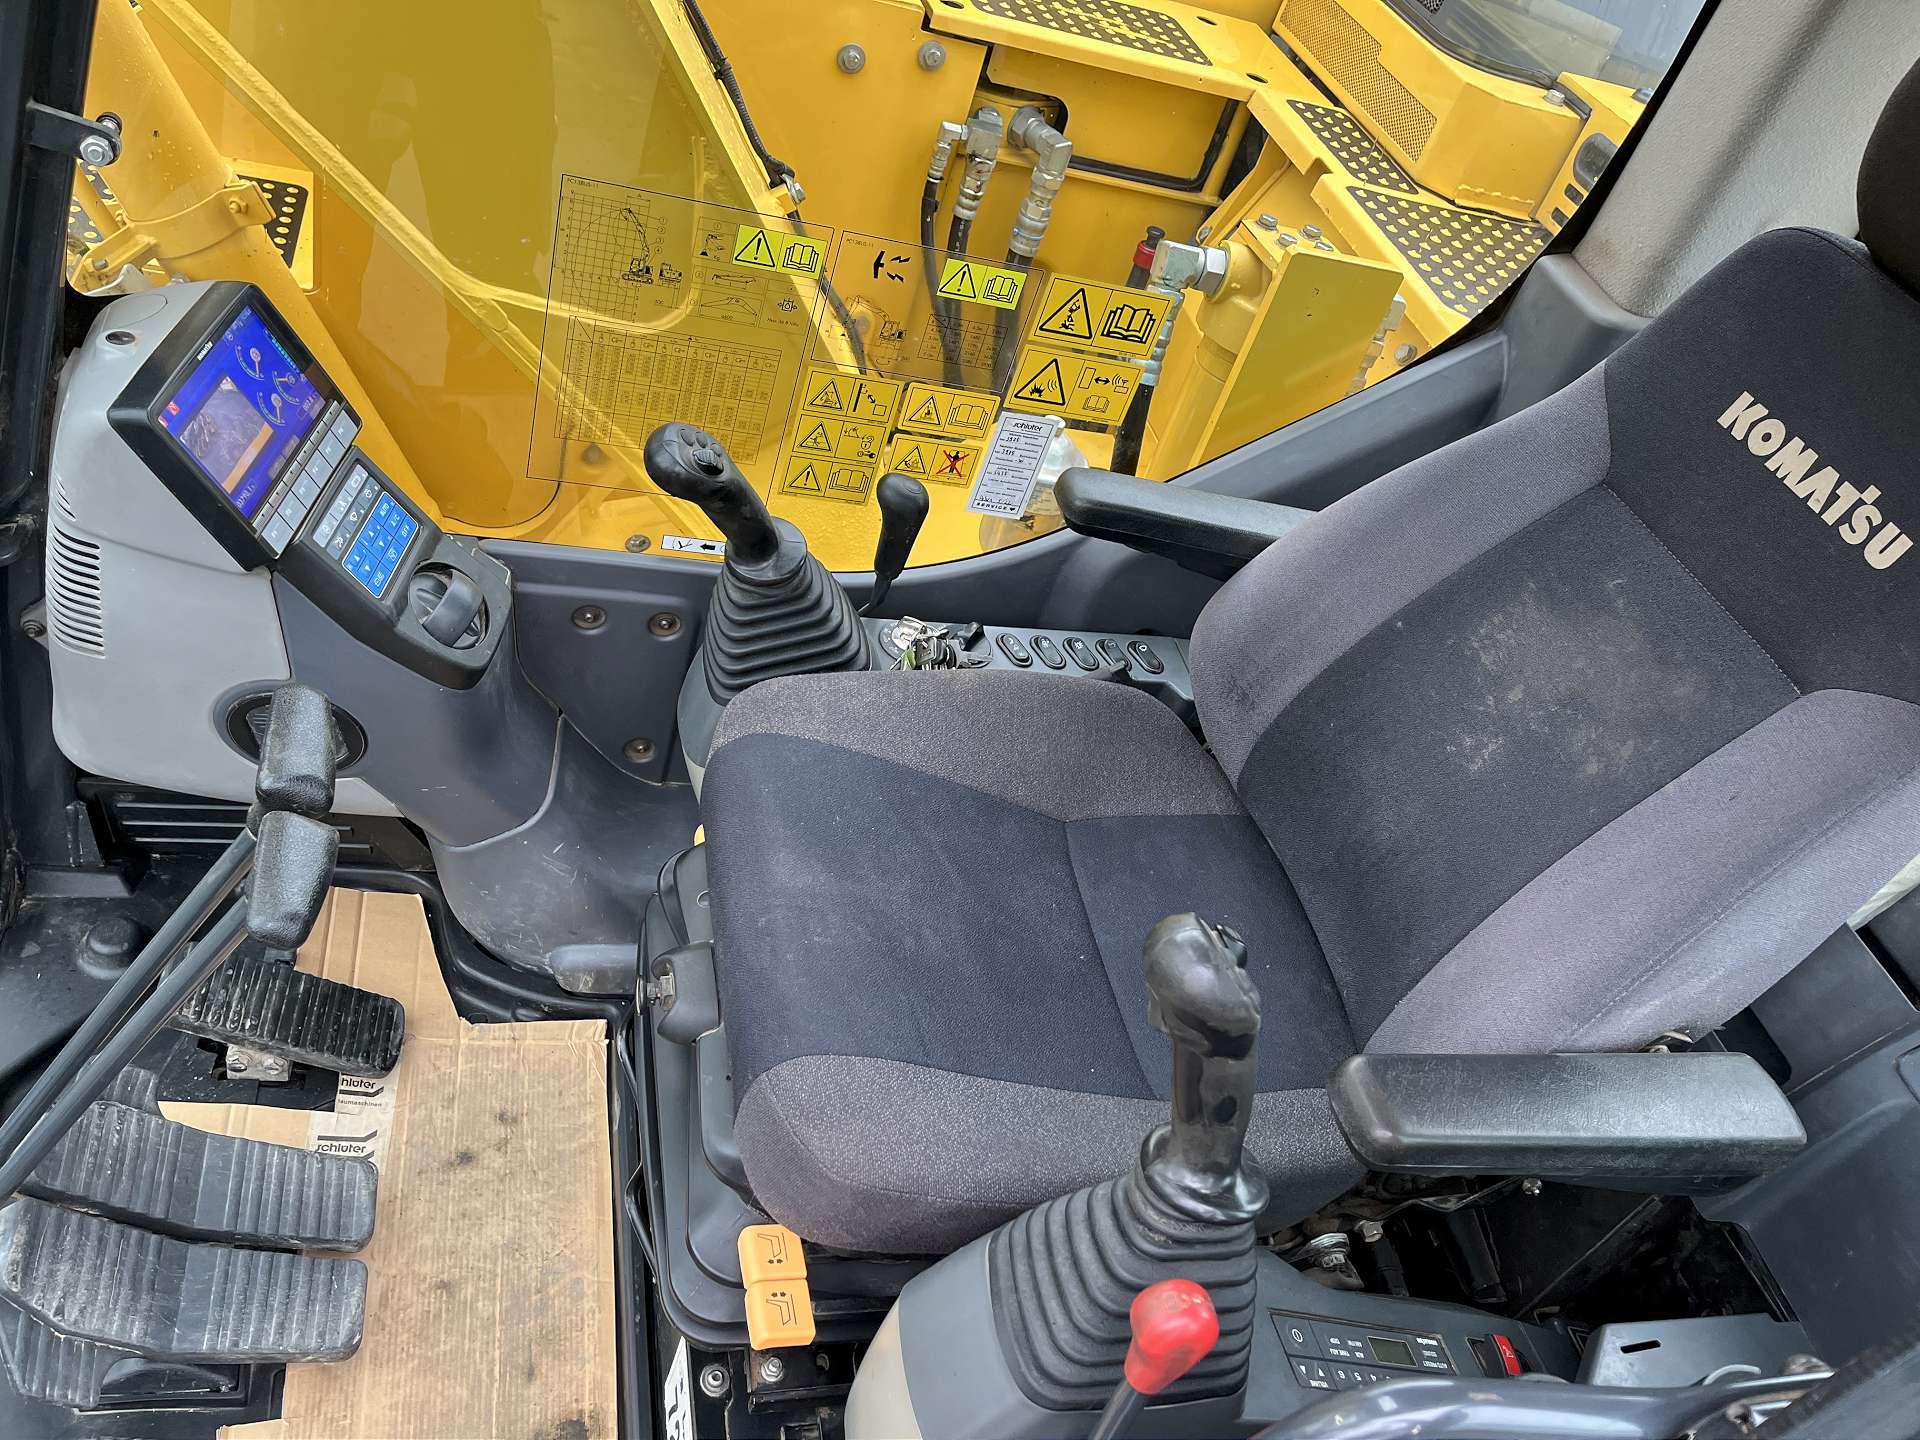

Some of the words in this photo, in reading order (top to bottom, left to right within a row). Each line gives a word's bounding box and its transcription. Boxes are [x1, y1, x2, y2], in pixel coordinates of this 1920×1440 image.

[1717, 390, 1914, 570] KOMATSU
[976, 502, 1008, 511] SERVICE
[391, 513, 400, 527] A/C
[401, 525, 410, 537] OFF
[1337, 1370, 1346, 1380] 6
[1354, 1372, 1362, 1381] 5
[1370, 1373, 1377, 1382] 4
